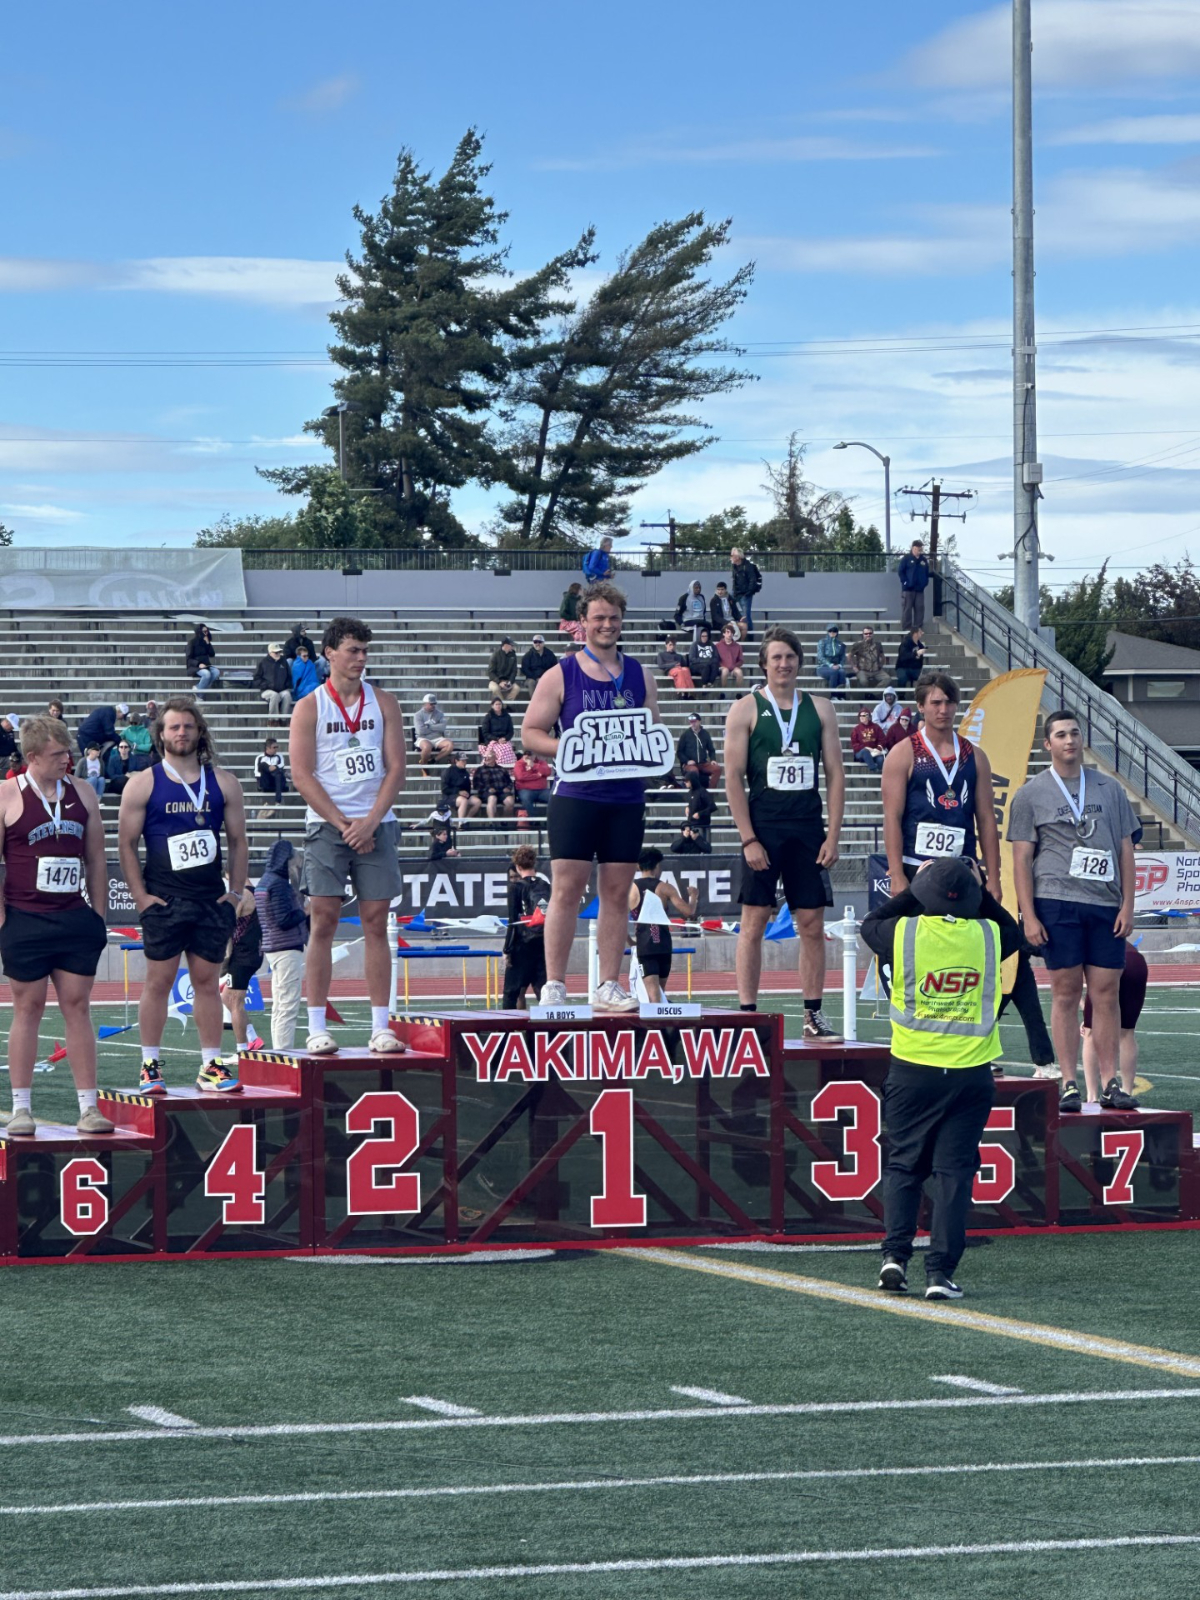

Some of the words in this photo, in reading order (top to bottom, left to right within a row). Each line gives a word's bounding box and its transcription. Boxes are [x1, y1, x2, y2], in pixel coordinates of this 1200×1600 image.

[326, 719, 375, 734] BULLGS
[581, 715, 646, 741] STATE
[345, 753, 376, 776] 938
[562, 730, 669, 773] CHAMP
[777, 765, 804, 784] 781
[165, 801, 212, 814] CONNL
[28, 819, 85, 846] STEVNS
[925, 831, 956, 852] 292
[178, 838, 209, 862] 343
[45, 866, 78, 886] 1476
[1082, 856, 1109, 876] 128
[1134, 865, 1169, 891] SP
[108, 889, 134, 900] Cre
[390, 873, 508, 908] TATE
[634, 870, 731, 903] ATE
[923, 971, 981, 994] NSP
[545, 1011, 555, 1020] 1A
[556, 1011, 576, 1020] BOYS
[657, 1006, 682, 1016] DISCUS
[345, 1091, 421, 1216] 2
[810, 1080, 882, 1201] 3
[590, 1088, 647, 1228] 1
[971, 1106, 1016, 1204] 5
[1101, 1129, 1145, 1206] 7
[204, 1124, 265, 1225] 4
[60, 1157, 109, 1236] 6
